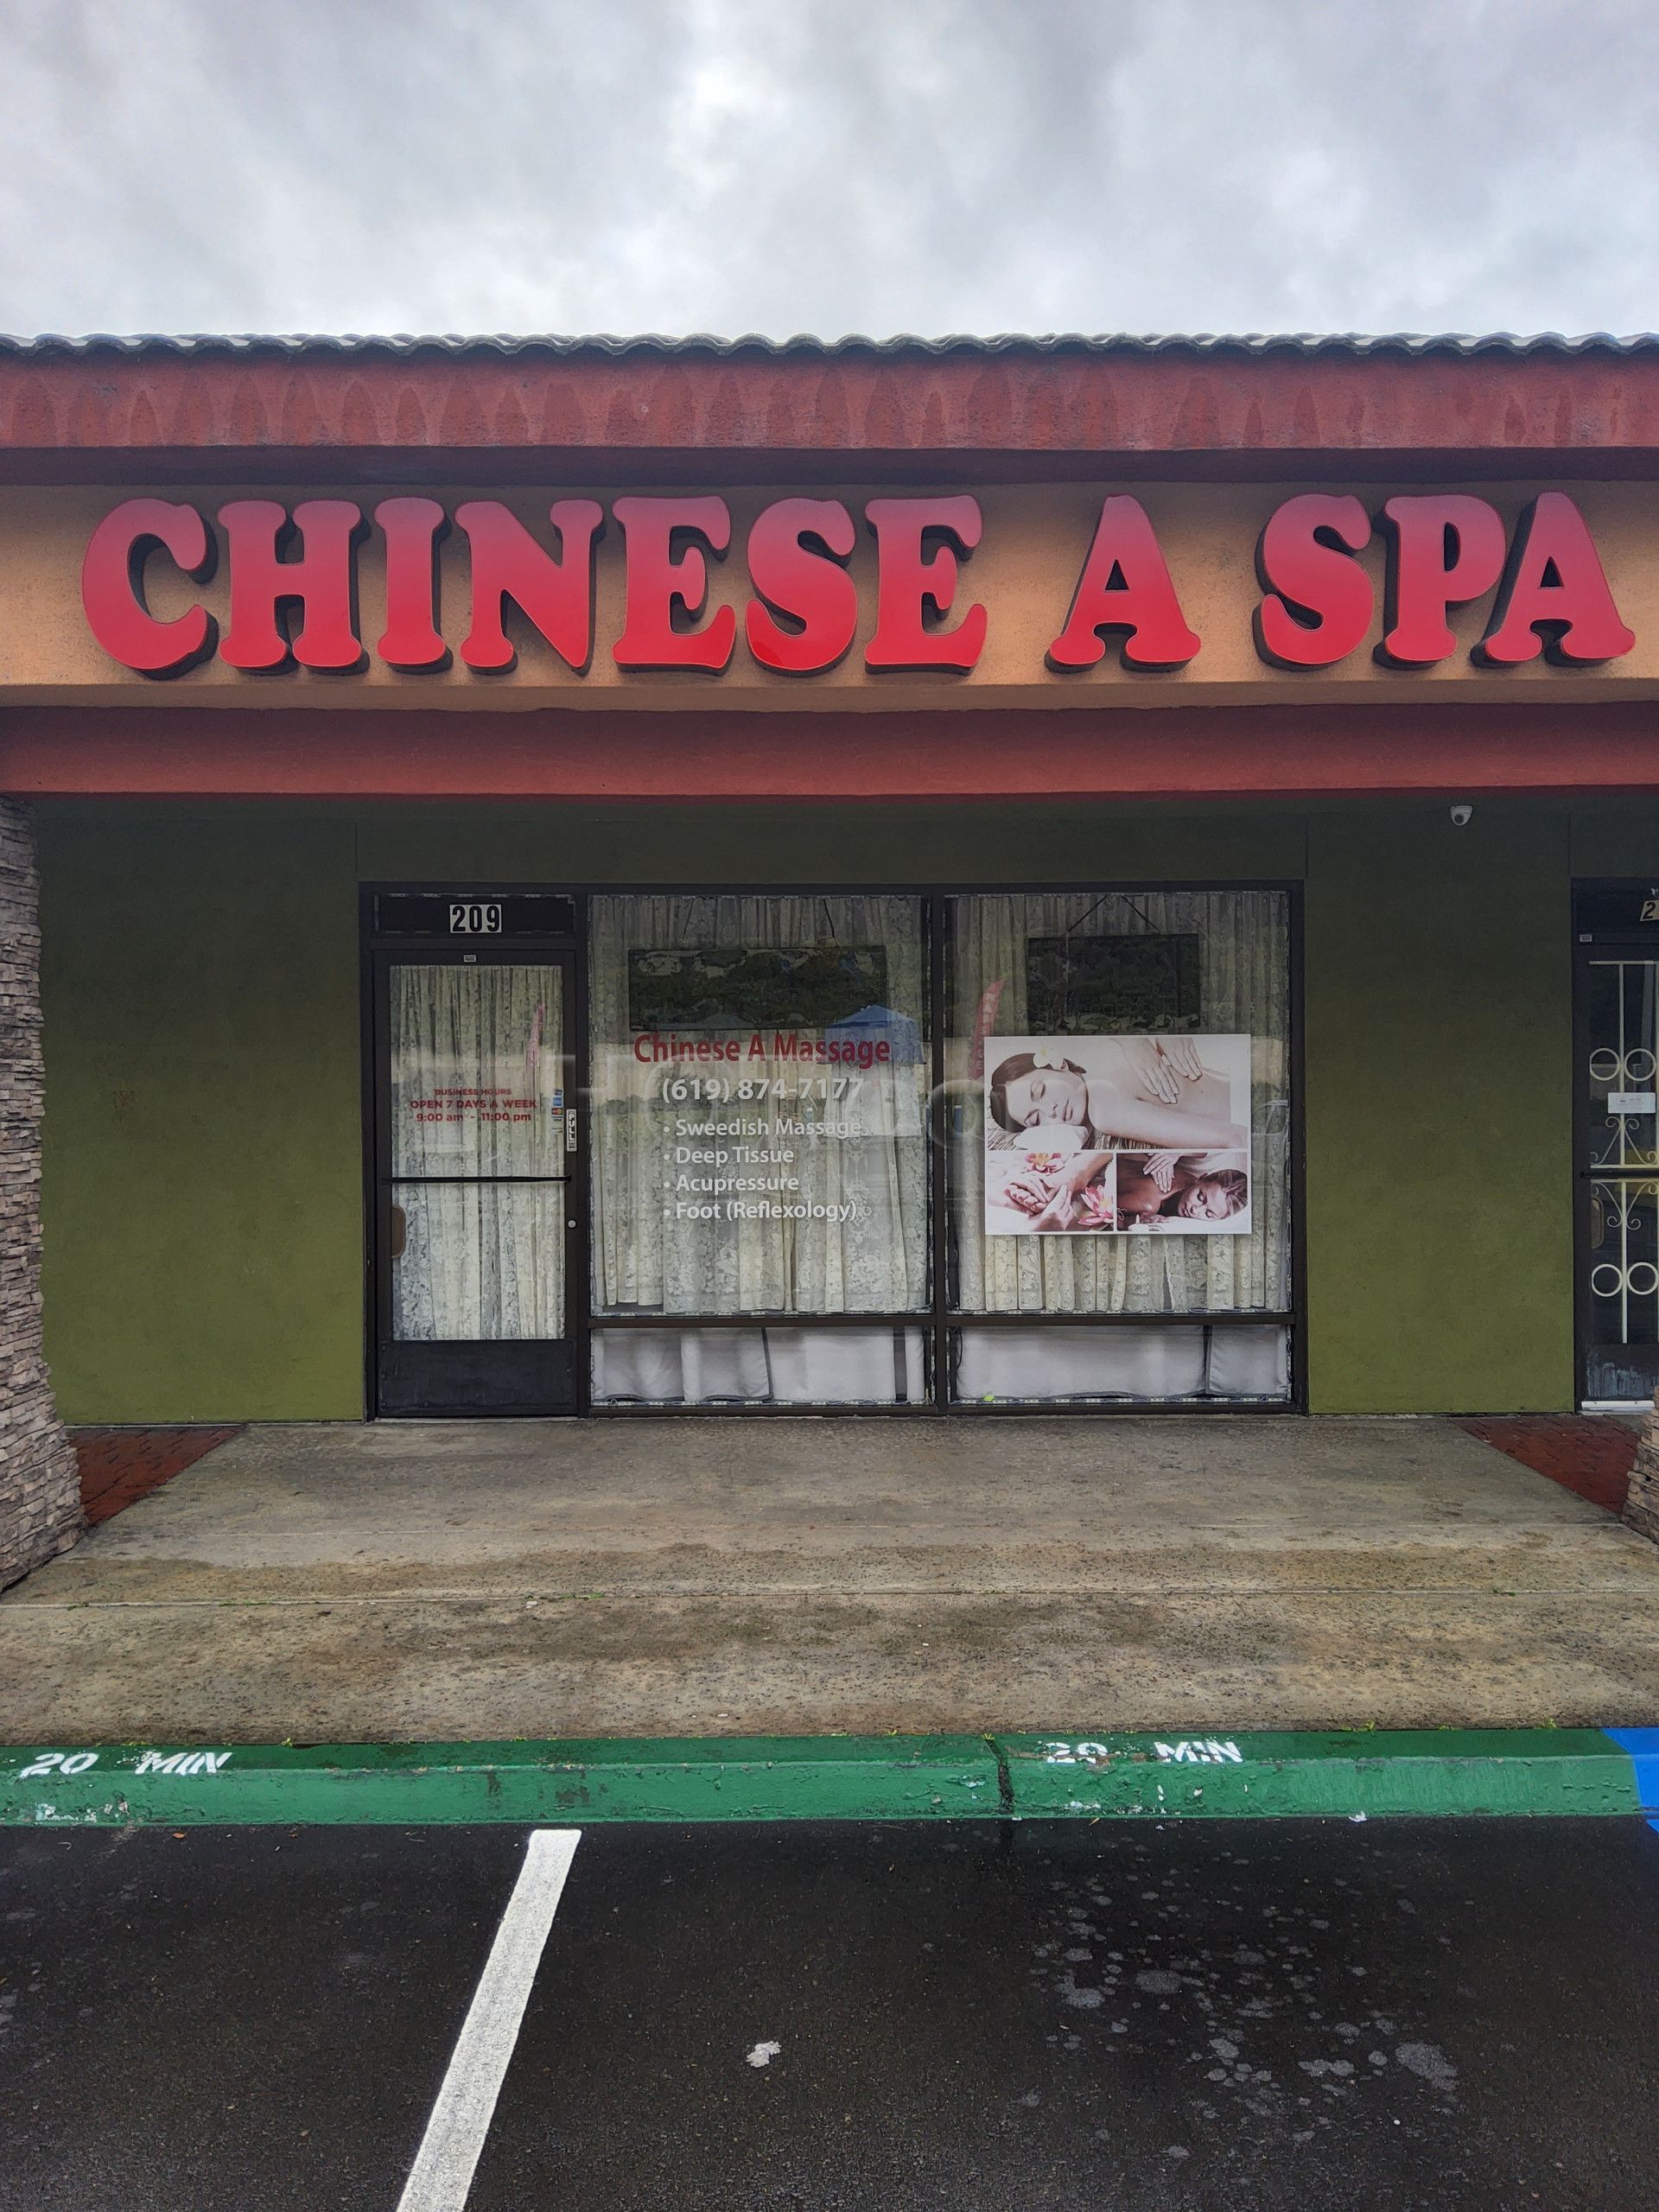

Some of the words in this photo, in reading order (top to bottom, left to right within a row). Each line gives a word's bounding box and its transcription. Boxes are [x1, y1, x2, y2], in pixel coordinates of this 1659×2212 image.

[82, 494, 988, 674] CHINESE
[1046, 493, 1201, 671] A
[1255, 492, 1637, 671] SPA
[452, 906, 500, 932] 209
[634, 1034, 741, 1063] Chinese
[747, 1034, 766, 1062] A
[774, 1034, 891, 1070] Massage
[663, 1077, 730, 1103] (619)
[737, 1078, 864, 1100] 874-7177
[410, 1100, 442, 1109] OPEN
[447, 1100, 454, 1109] 7
[456, 1100, 486, 1109] DAYS
[490, 1100, 499, 1109] A
[503, 1100, 537, 1109] WEEK
[416, 1113, 442, 1122] 9:00
[481, 1112, 510, 1122] 11:00
[513, 1113, 531, 1122] pm
[676, 1119, 769, 1136] Sweedish
[776, 1119, 861, 1139] Massage
[676, 1147, 728, 1167] Deep
[732, 1146, 794, 1163] Tissue
[676, 1174, 799, 1195] Acupressure
[676, 1202, 721, 1219] Foot
[727, 1200, 856, 1223] (Reflexology)
[1154, 1740, 1244, 1764] MIN
[19, 1753, 100, 1778] 20
[135, 1751, 233, 1776] MIN
